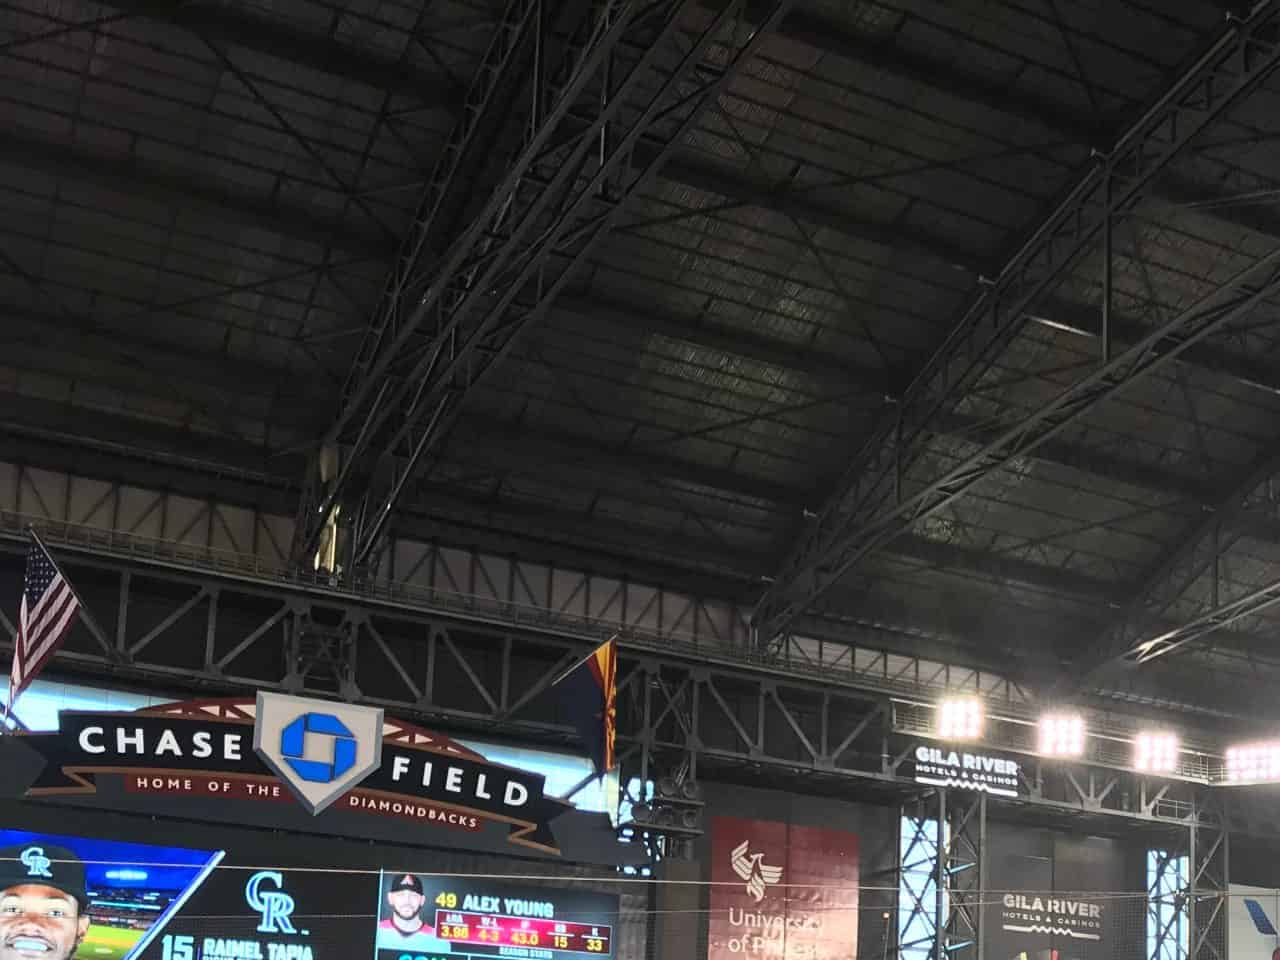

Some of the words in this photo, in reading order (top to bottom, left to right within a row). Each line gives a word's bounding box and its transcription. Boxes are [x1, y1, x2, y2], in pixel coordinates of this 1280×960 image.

[79, 727, 242, 760] CHASE
[392, 756, 528, 806] FIELD
[915, 764, 957, 776] HOTELS
[916, 746, 960, 767] GILA
[963, 753, 1018, 776] RIVER
[137, 778, 192, 790] HOME
[208, 781, 231, 792] OF
[246, 784, 280, 796] THE
[350, 796, 477, 828] DIAMONDBACKS
[435, 892, 457, 909] 49
[463, 894, 500, 913] ALEX
[505, 900, 554, 918] YOUNG
[1003, 894, 1045, 911] GILA
[1047, 899, 1101, 918] RIVER
[511, 933, 539, 946] 43.0
[554, 936, 568, 949] 15
[586, 939, 603, 952] 33
[728, 934, 749, 952] of
